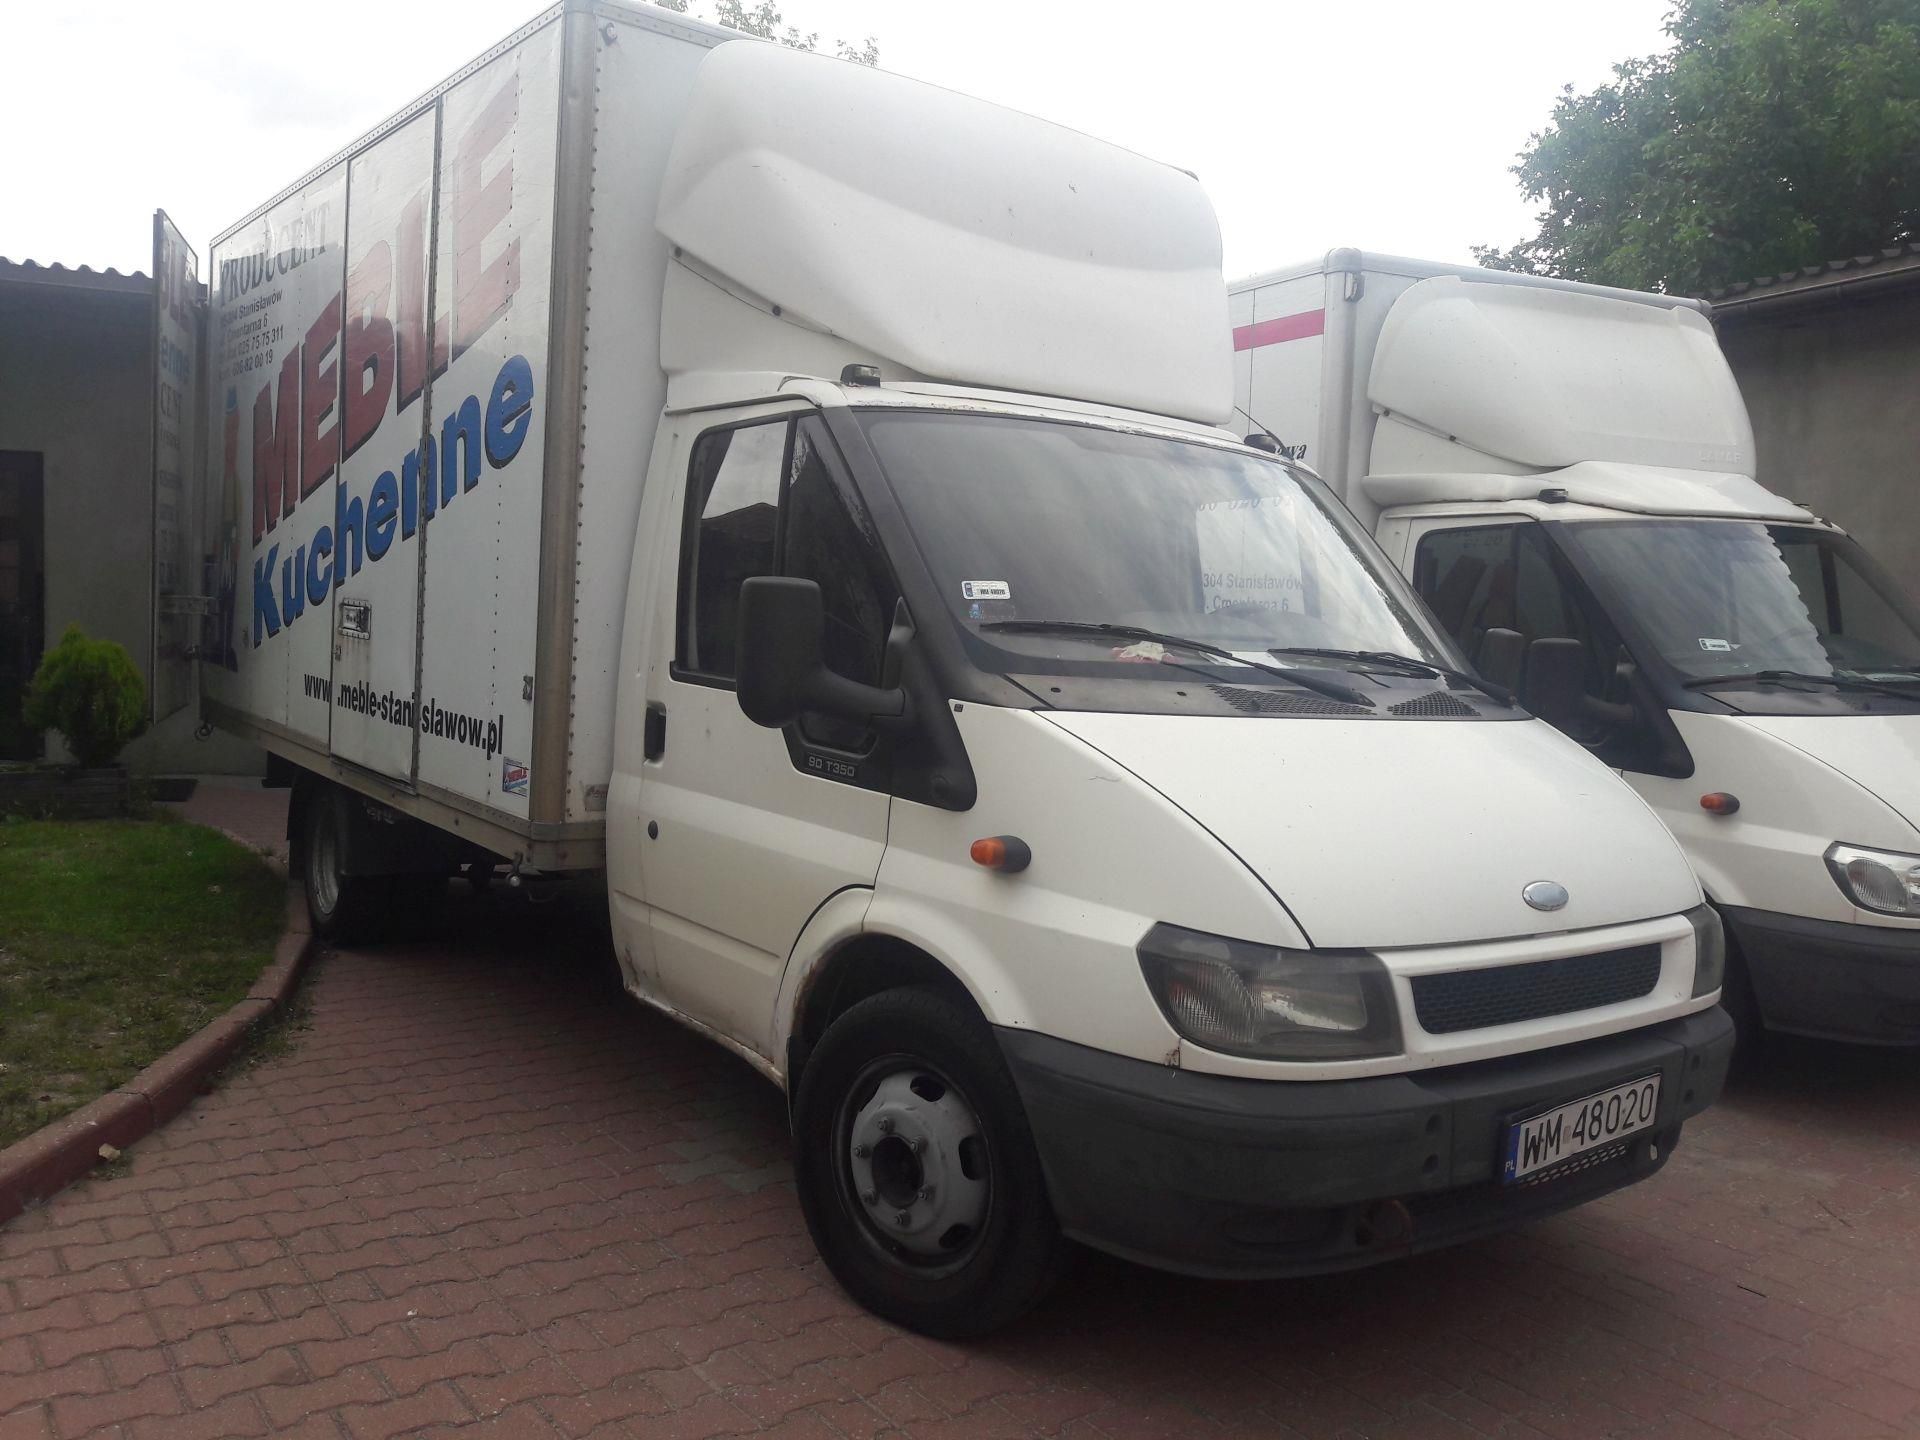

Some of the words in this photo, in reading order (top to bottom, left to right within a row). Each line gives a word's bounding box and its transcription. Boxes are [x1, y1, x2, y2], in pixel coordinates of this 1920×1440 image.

[219, 200, 331, 307] PRODUCENT
[252, 72, 521, 548] MEBLE
[263, 313, 269, 328] 6
[253, 354, 535, 649] Kuchenne
[826, 760, 855, 777] T350
[1504, 1159, 1515, 1174] PL
[1522, 1113, 1563, 1169] WM
[1571, 1083, 1655, 1146] 48020
